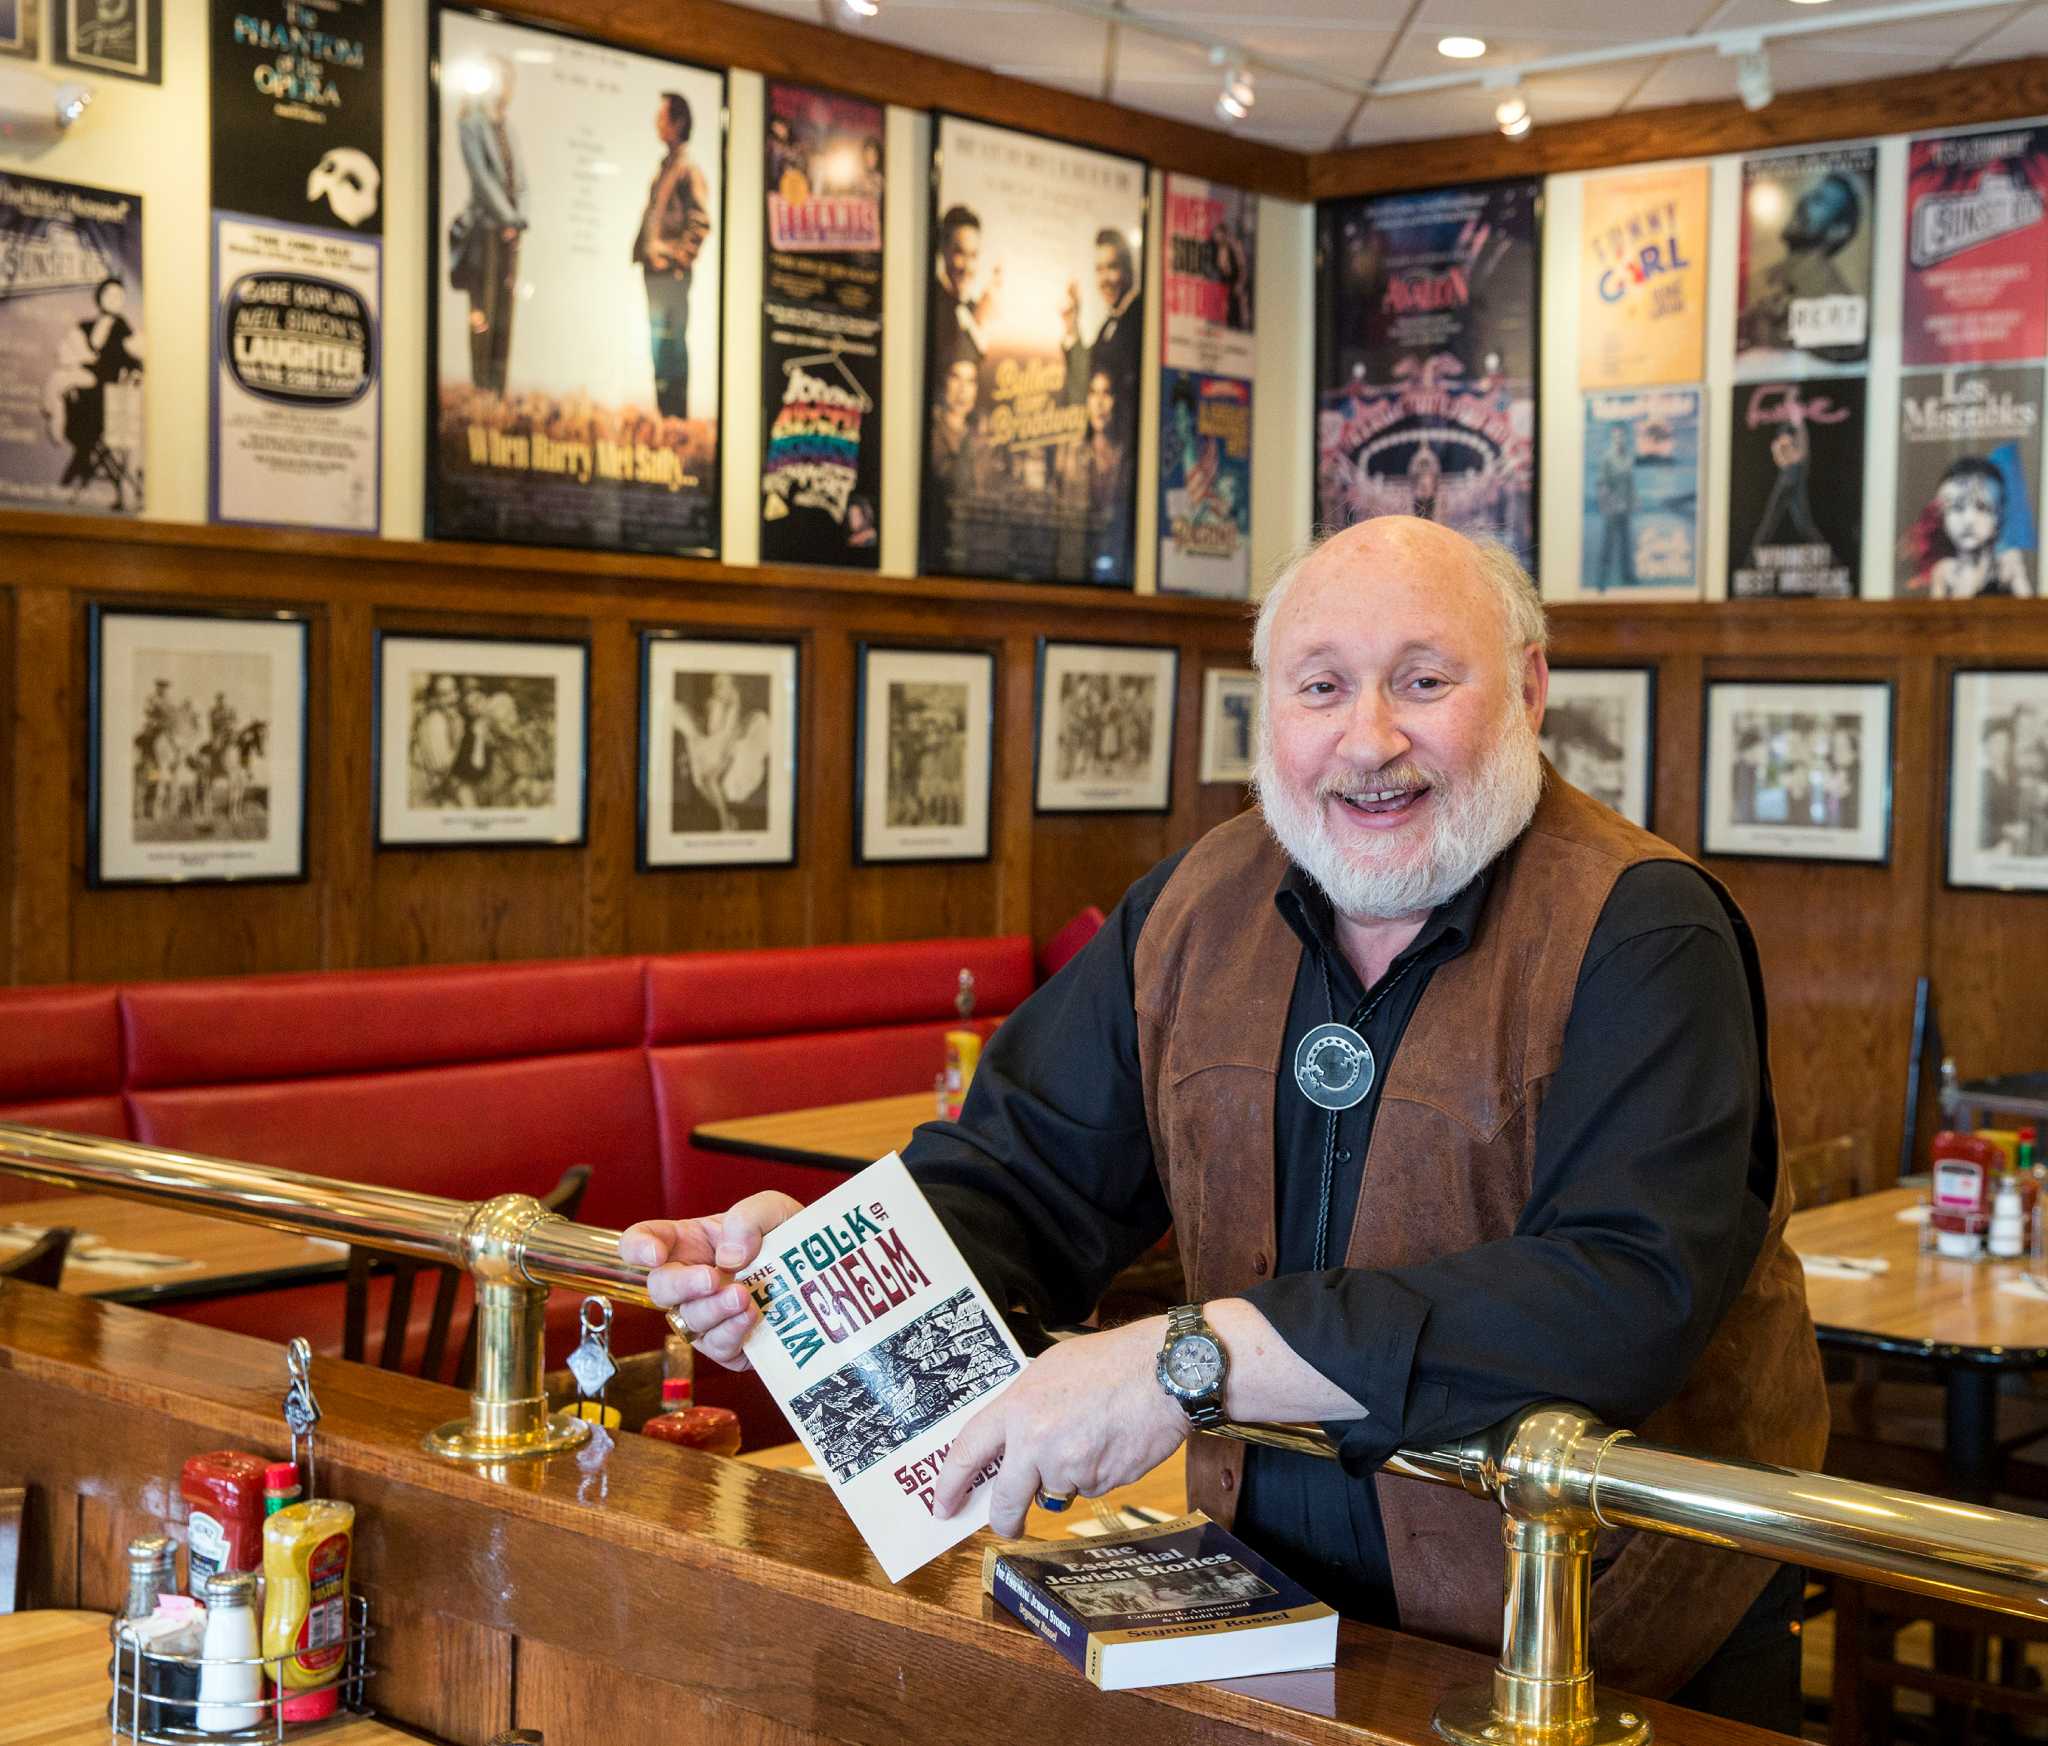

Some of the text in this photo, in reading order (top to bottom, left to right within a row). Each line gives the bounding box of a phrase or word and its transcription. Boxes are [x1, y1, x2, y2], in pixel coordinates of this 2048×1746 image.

[254, 64, 342, 107] OPERA
[531, 432, 593, 484] Harry
[869, 1201, 890, 1222] OF
[779, 1204, 883, 1286] FOLK
[743, 1263, 776, 1287] THE
[800, 1227, 933, 1345] CHELM
[751, 1273, 826, 1370] WISE
[1044, 1551, 1233, 1586] Jewish Stories
[1064, 1548, 1185, 1573] Essential
[1084, 1545, 1138, 1560] The
[1127, 1611, 1291, 1639] Seymour Rossel
